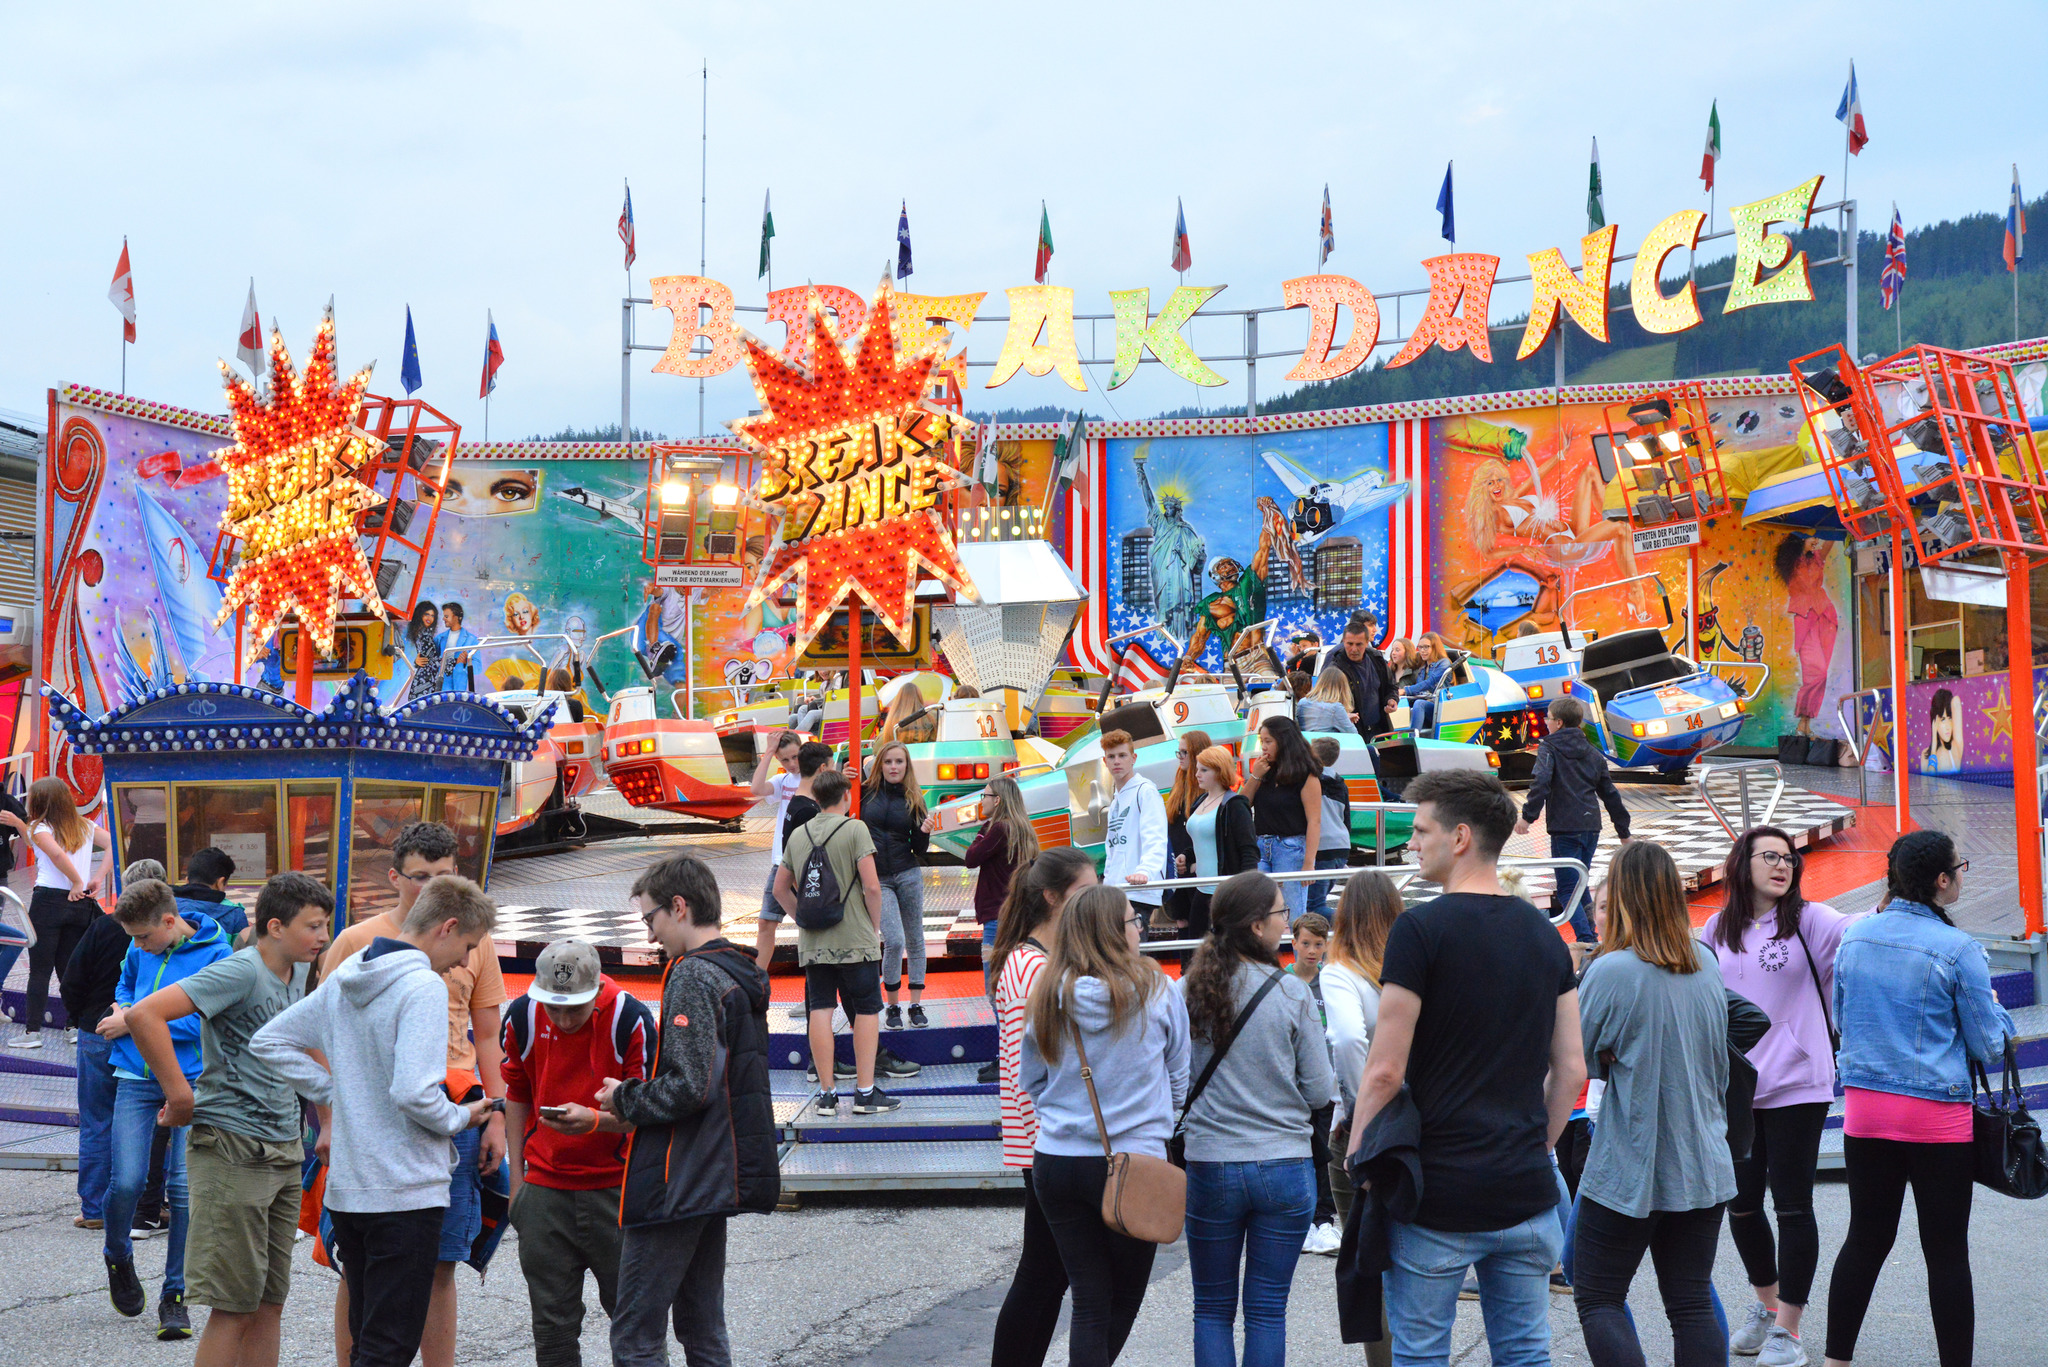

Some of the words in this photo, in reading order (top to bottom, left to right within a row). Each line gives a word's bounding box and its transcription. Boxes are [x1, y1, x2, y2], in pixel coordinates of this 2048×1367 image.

[651, 275, 1229, 392] BREAK
[1281, 174, 1825, 382] DANCE
[758, 412, 952, 502] BREAK
[781, 457, 938, 544] DANCE
[1633, 530, 1657, 542] BETRETEN
[1657, 528, 1667, 538] DER
[1668, 523, 1698, 536] PLATTFORM
[1642, 541, 1653, 551] NUR
[1653, 539, 1662, 549] BEI
[1662, 534, 1691, 547] STILLSTAND
[1536, 645, 1560, 665] 13
[613, 702, 622, 722] 8
[1173, 701, 1189, 724] 9
[1247, 707, 1260, 732] 10
[1685, 713, 1703, 731] 14
[977, 715, 998, 738] 12
[933, 811, 943, 831] 11
